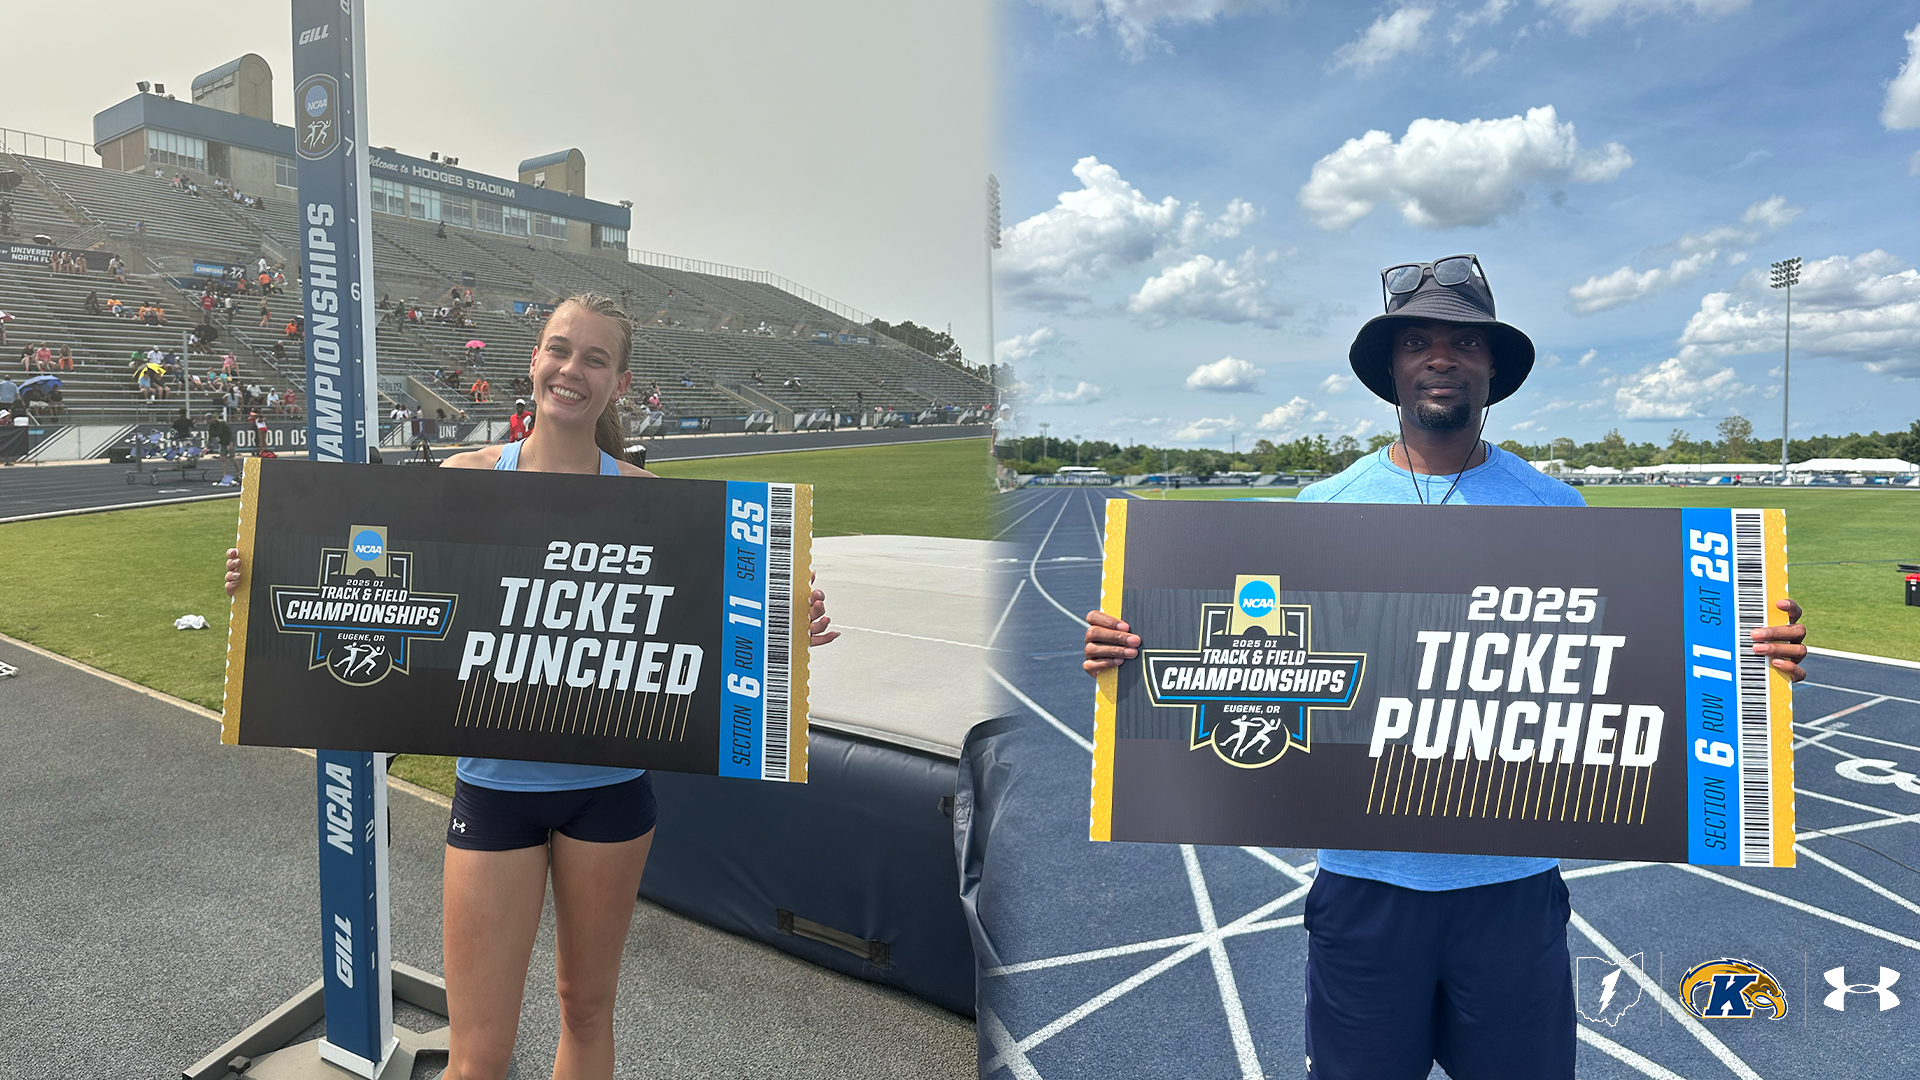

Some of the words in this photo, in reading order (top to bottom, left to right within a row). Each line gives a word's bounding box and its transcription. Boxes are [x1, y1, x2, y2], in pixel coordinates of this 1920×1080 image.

[299, 24, 329, 45] GILL
[307, 99, 328, 111] NCAA
[344, 136, 355, 157] 7
[400, 164, 409, 174] to
[412, 165, 463, 187] HODGES
[467, 178, 515, 198] STADIUM
[11, 253, 39, 262] NORTH
[350, 282, 361, 301] 6
[307, 203, 344, 462] AMPIONSHIPS
[354, 420, 365, 438] 5
[439, 425, 457, 438] UNF
[731, 498, 764, 546] 25
[355, 544, 382, 554] NCAA
[544, 540, 654, 575] 2025
[737, 547, 755, 581] SEAT
[1689, 528, 1730, 583] 25
[321, 586, 360, 600] TRACK
[362, 588, 371, 600] &
[374, 588, 408, 603] FIELD
[346, 578, 370, 587] 2025
[286, 600, 441, 626] CHAMPIONSHIPS
[500, 576, 675, 635] TICKET
[729, 595, 762, 628] 11
[1242, 598, 1274, 608] NCAA
[1467, 585, 1599, 623] 2025
[1699, 585, 1722, 626] SEAT
[337, 632, 371, 642] EUGENE,
[373, 634, 385, 642] OR
[735, 635, 754, 670] ROW
[1232, 639, 1261, 648] 2025
[1264, 640, 1277, 648] DI
[457, 631, 704, 695] PUNCHED
[1202, 649, 1248, 665] TRACK
[1251, 650, 1263, 665] &
[1266, 650, 1306, 666] FIELD
[1416, 630, 1626, 695] TICKET
[1692, 644, 1732, 682] 11
[727, 672, 760, 699] 6
[1161, 667, 1346, 693] CHAMPIONSHIPS
[1223, 704, 1263, 715] EUGENE,
[1266, 705, 1280, 714] OR
[1702, 693, 1724, 734] ROW
[732, 704, 752, 767] SECTION
[1368, 697, 1665, 767] PUNCHED
[1694, 737, 1735, 768] 6
[326, 762, 353, 855] NCAA
[1704, 776, 1726, 851] SECTION
[334, 913, 354, 989] GILL
